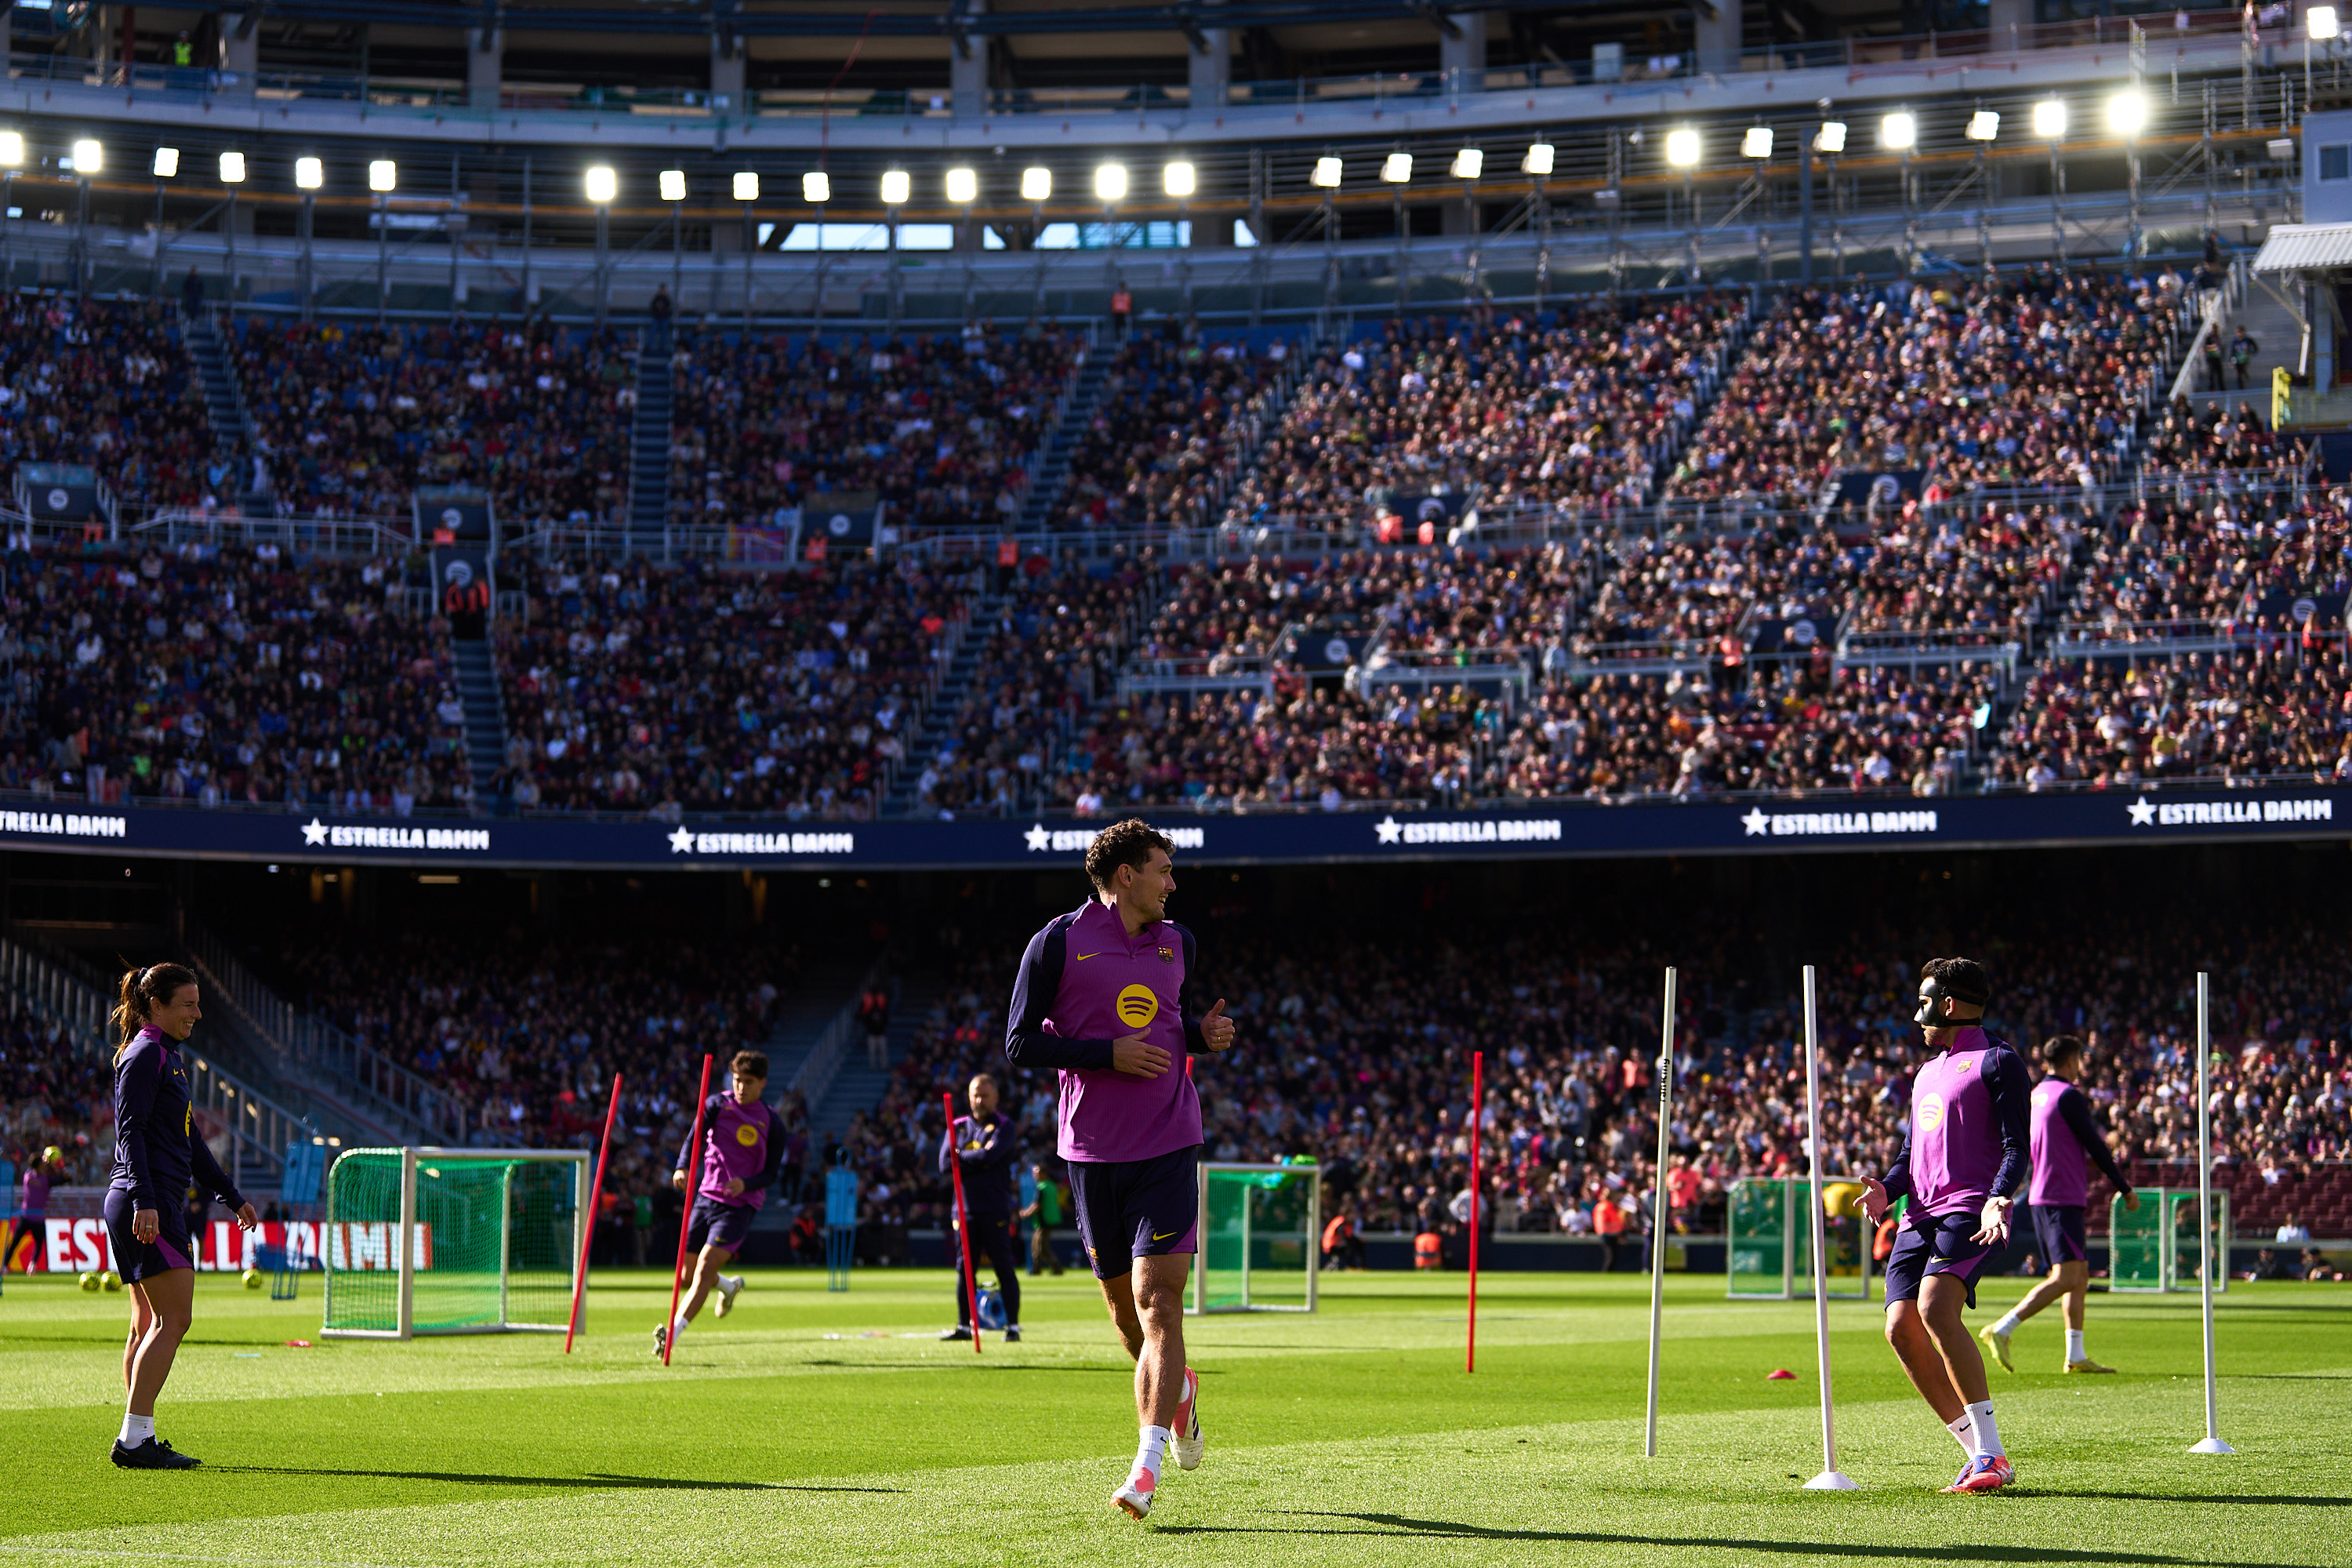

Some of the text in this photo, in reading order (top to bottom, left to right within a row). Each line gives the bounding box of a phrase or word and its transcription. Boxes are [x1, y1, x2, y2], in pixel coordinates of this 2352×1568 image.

[1771, 811, 1937, 836] ESTRELLA DAMM
[2158, 799, 2332, 825] ESTRELLA DAMM
[65, 814, 126, 838] DAMM
[331, 826, 490, 851] ESTRELLA DAMM
[1403, 819, 1562, 844] ESTRELLA DAMM
[696, 832, 854, 854] ESTRELLA DAMM
